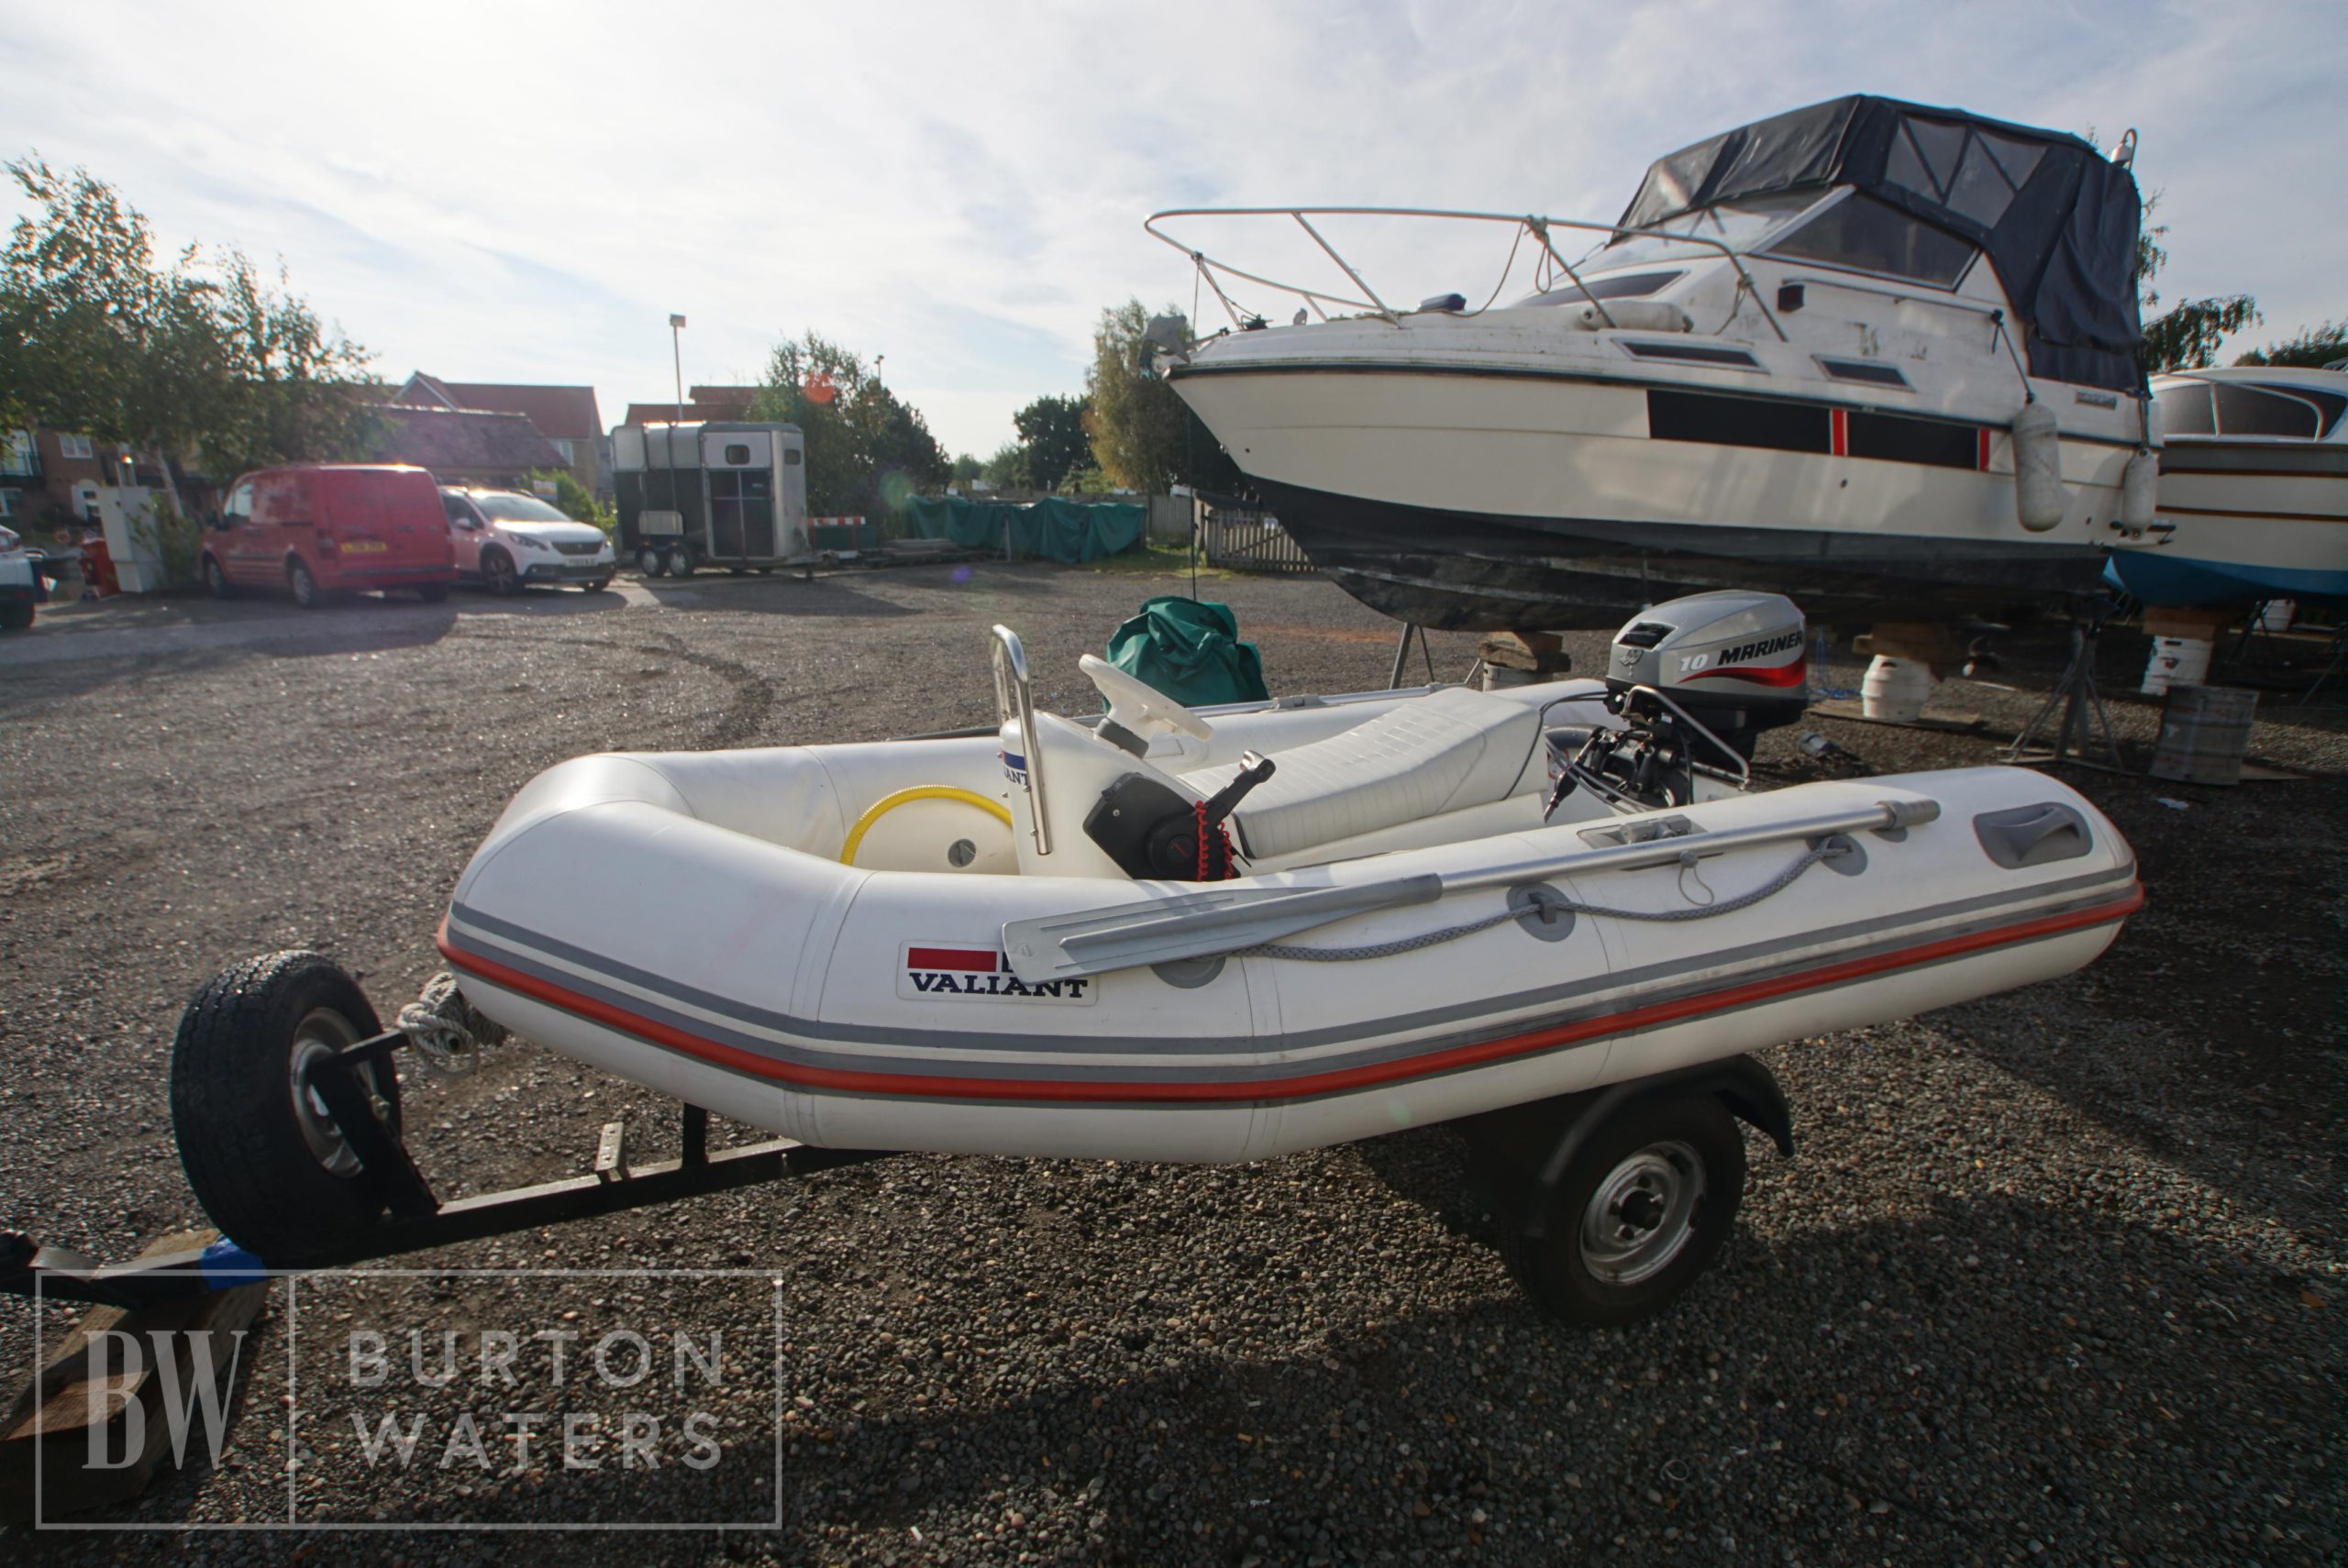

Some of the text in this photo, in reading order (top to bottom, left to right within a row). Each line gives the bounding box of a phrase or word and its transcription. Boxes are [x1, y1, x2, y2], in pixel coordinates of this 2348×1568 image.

[1679, 630, 1803, 672] 10 MARINER
[908, 972, 1089, 999] VALIANT
